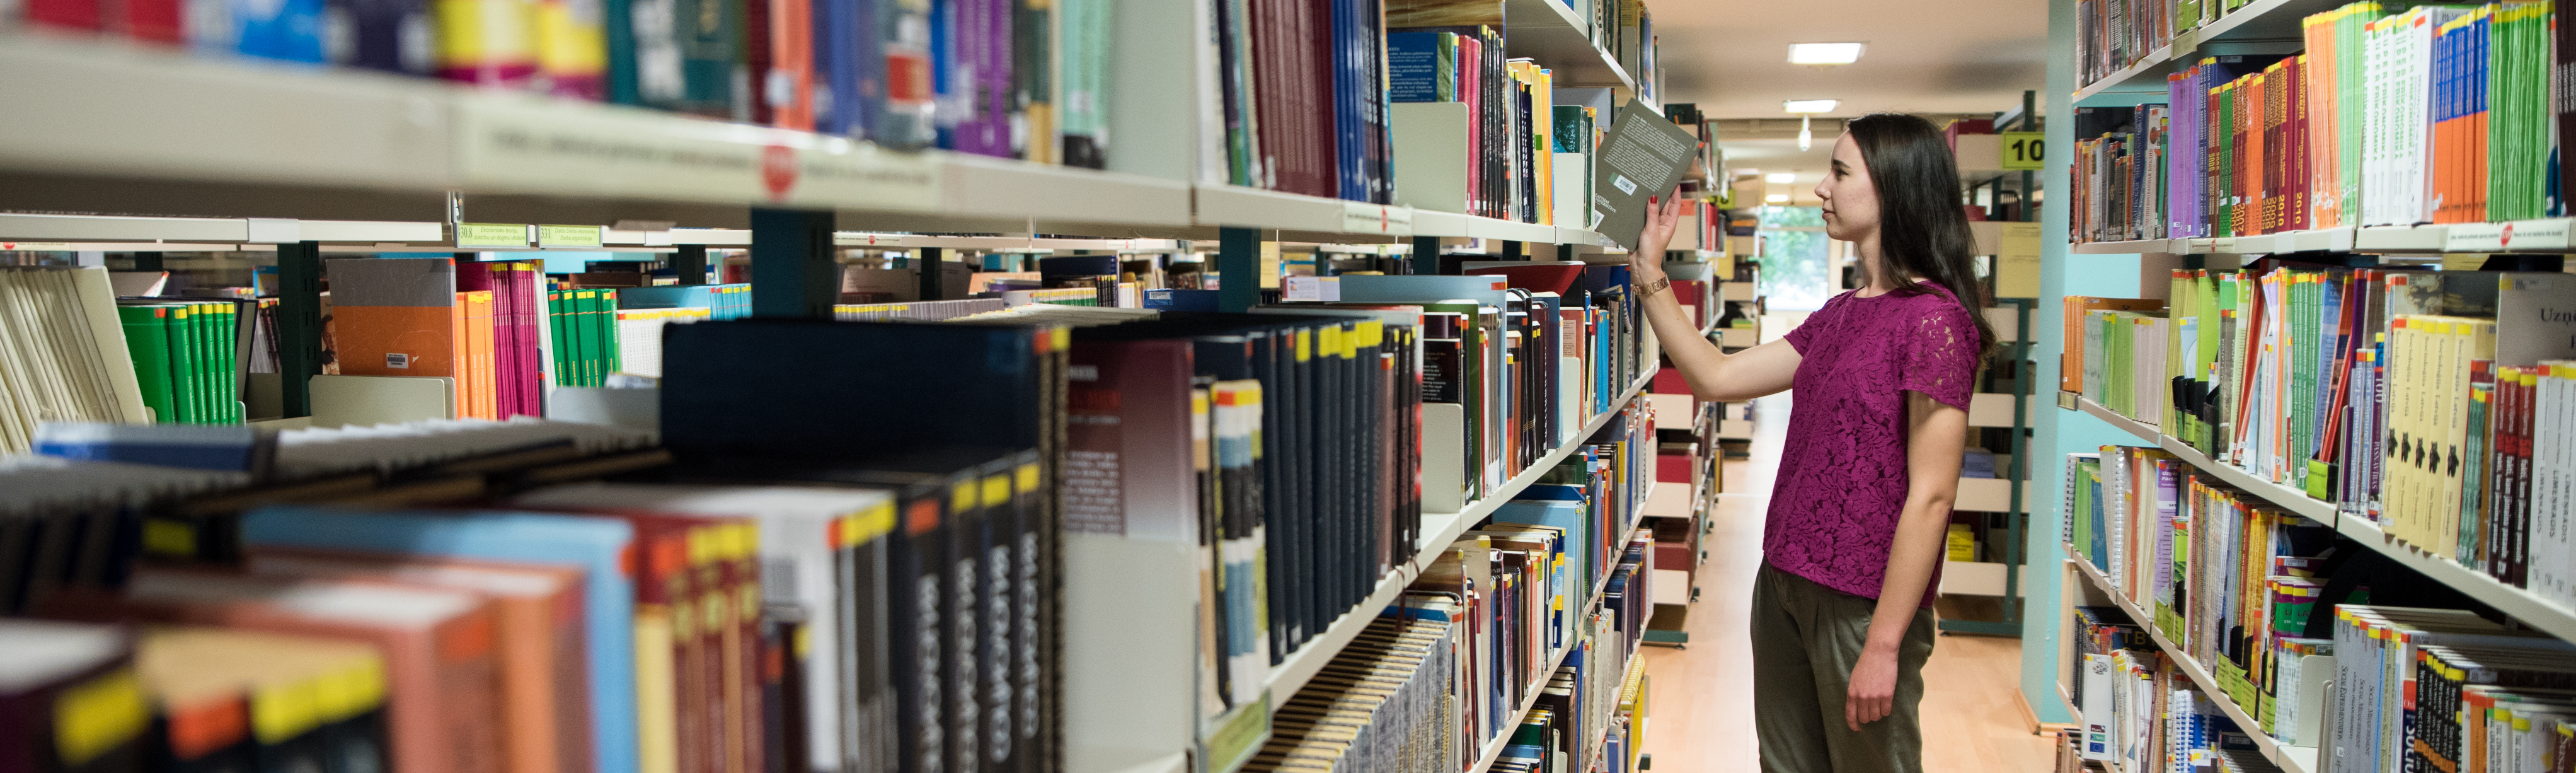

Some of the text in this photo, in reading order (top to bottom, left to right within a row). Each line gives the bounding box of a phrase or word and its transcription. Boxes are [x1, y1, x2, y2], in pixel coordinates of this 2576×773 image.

[2012, 139, 2045, 161] 10
[1595, 198, 1617, 213] NIVERSITĀTE
[541, 228, 551, 238] 331
[2375, 377, 2383, 403] 100
